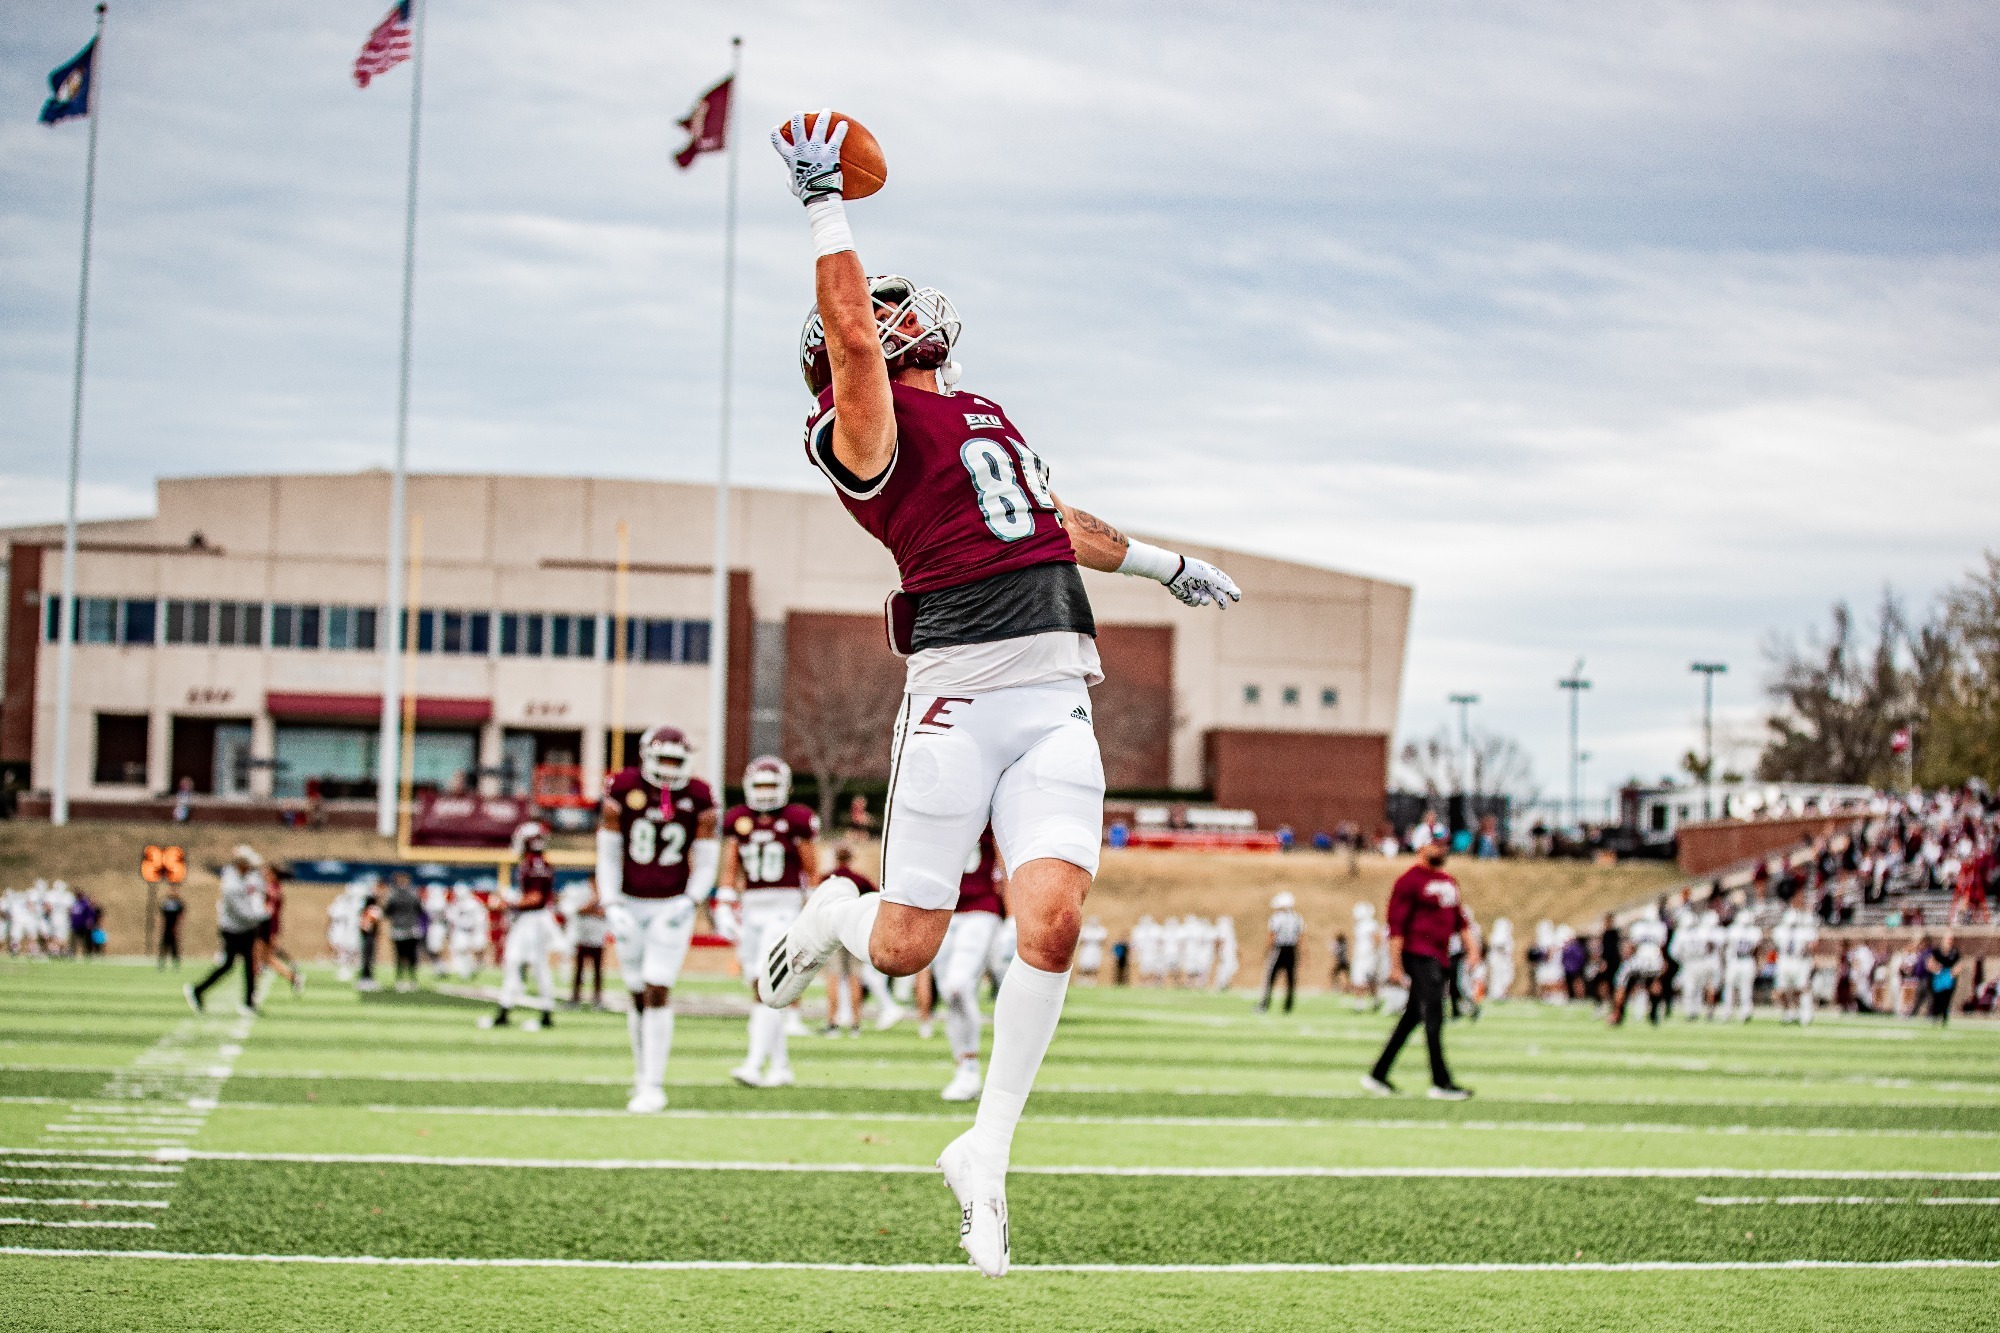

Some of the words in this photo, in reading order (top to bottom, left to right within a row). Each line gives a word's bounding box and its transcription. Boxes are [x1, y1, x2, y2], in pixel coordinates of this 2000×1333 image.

[798, 162, 823, 187] adidas
[963, 413, 1003, 427] EKU
[918, 696, 975, 730] E
[628, 817, 687, 867] 82
